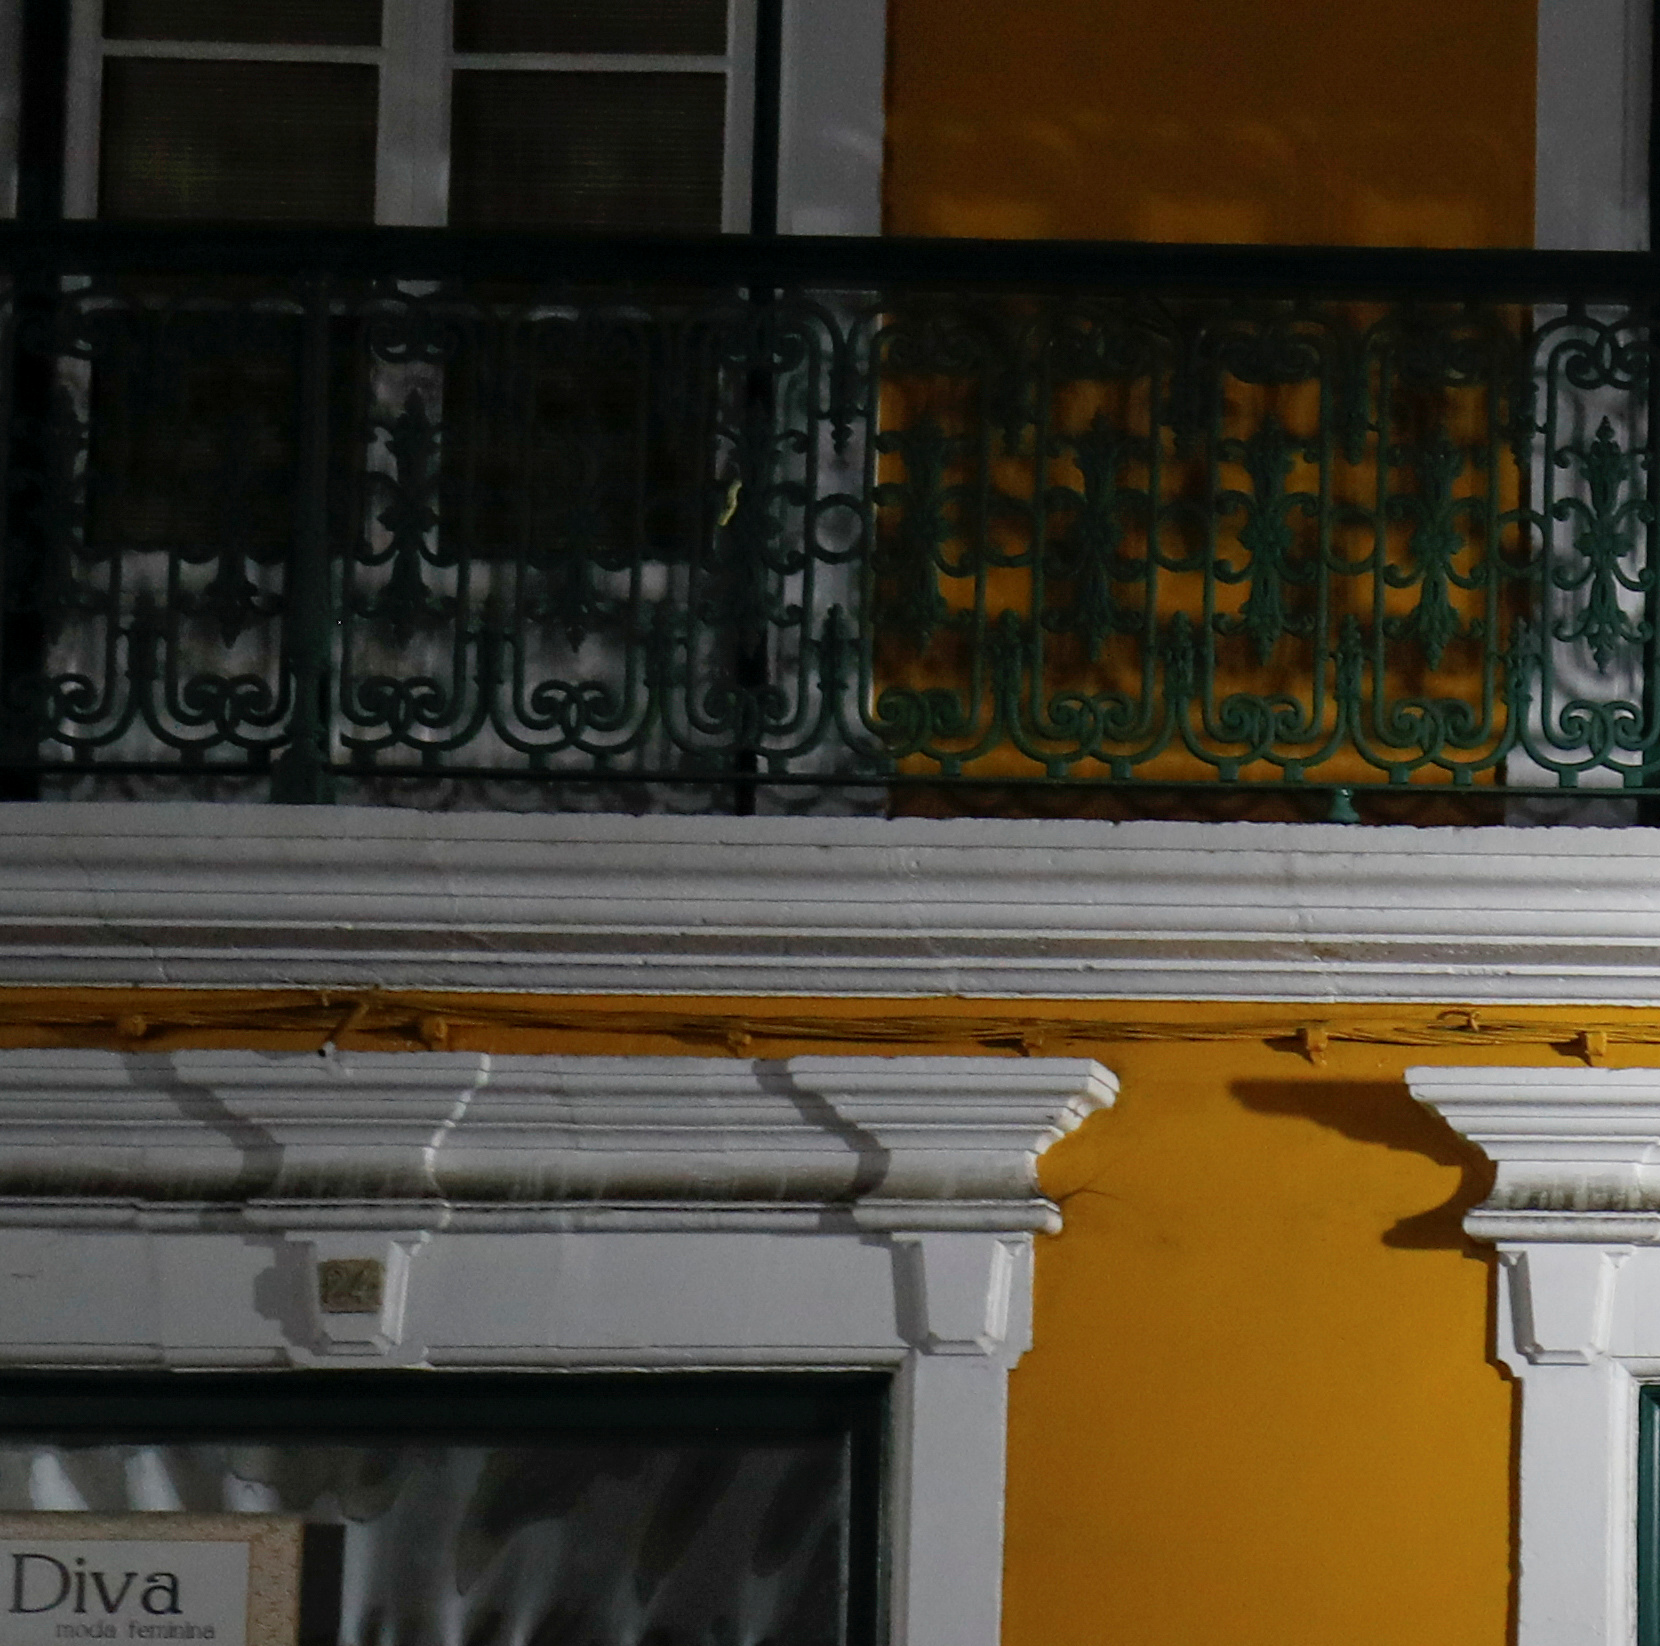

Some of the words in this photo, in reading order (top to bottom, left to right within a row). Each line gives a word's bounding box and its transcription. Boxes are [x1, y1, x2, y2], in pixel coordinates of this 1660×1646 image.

[8, 1552, 185, 1616] Diva
[55, 1619, 118, 1640] moda
[128, 1620, 217, 1641] feminina
